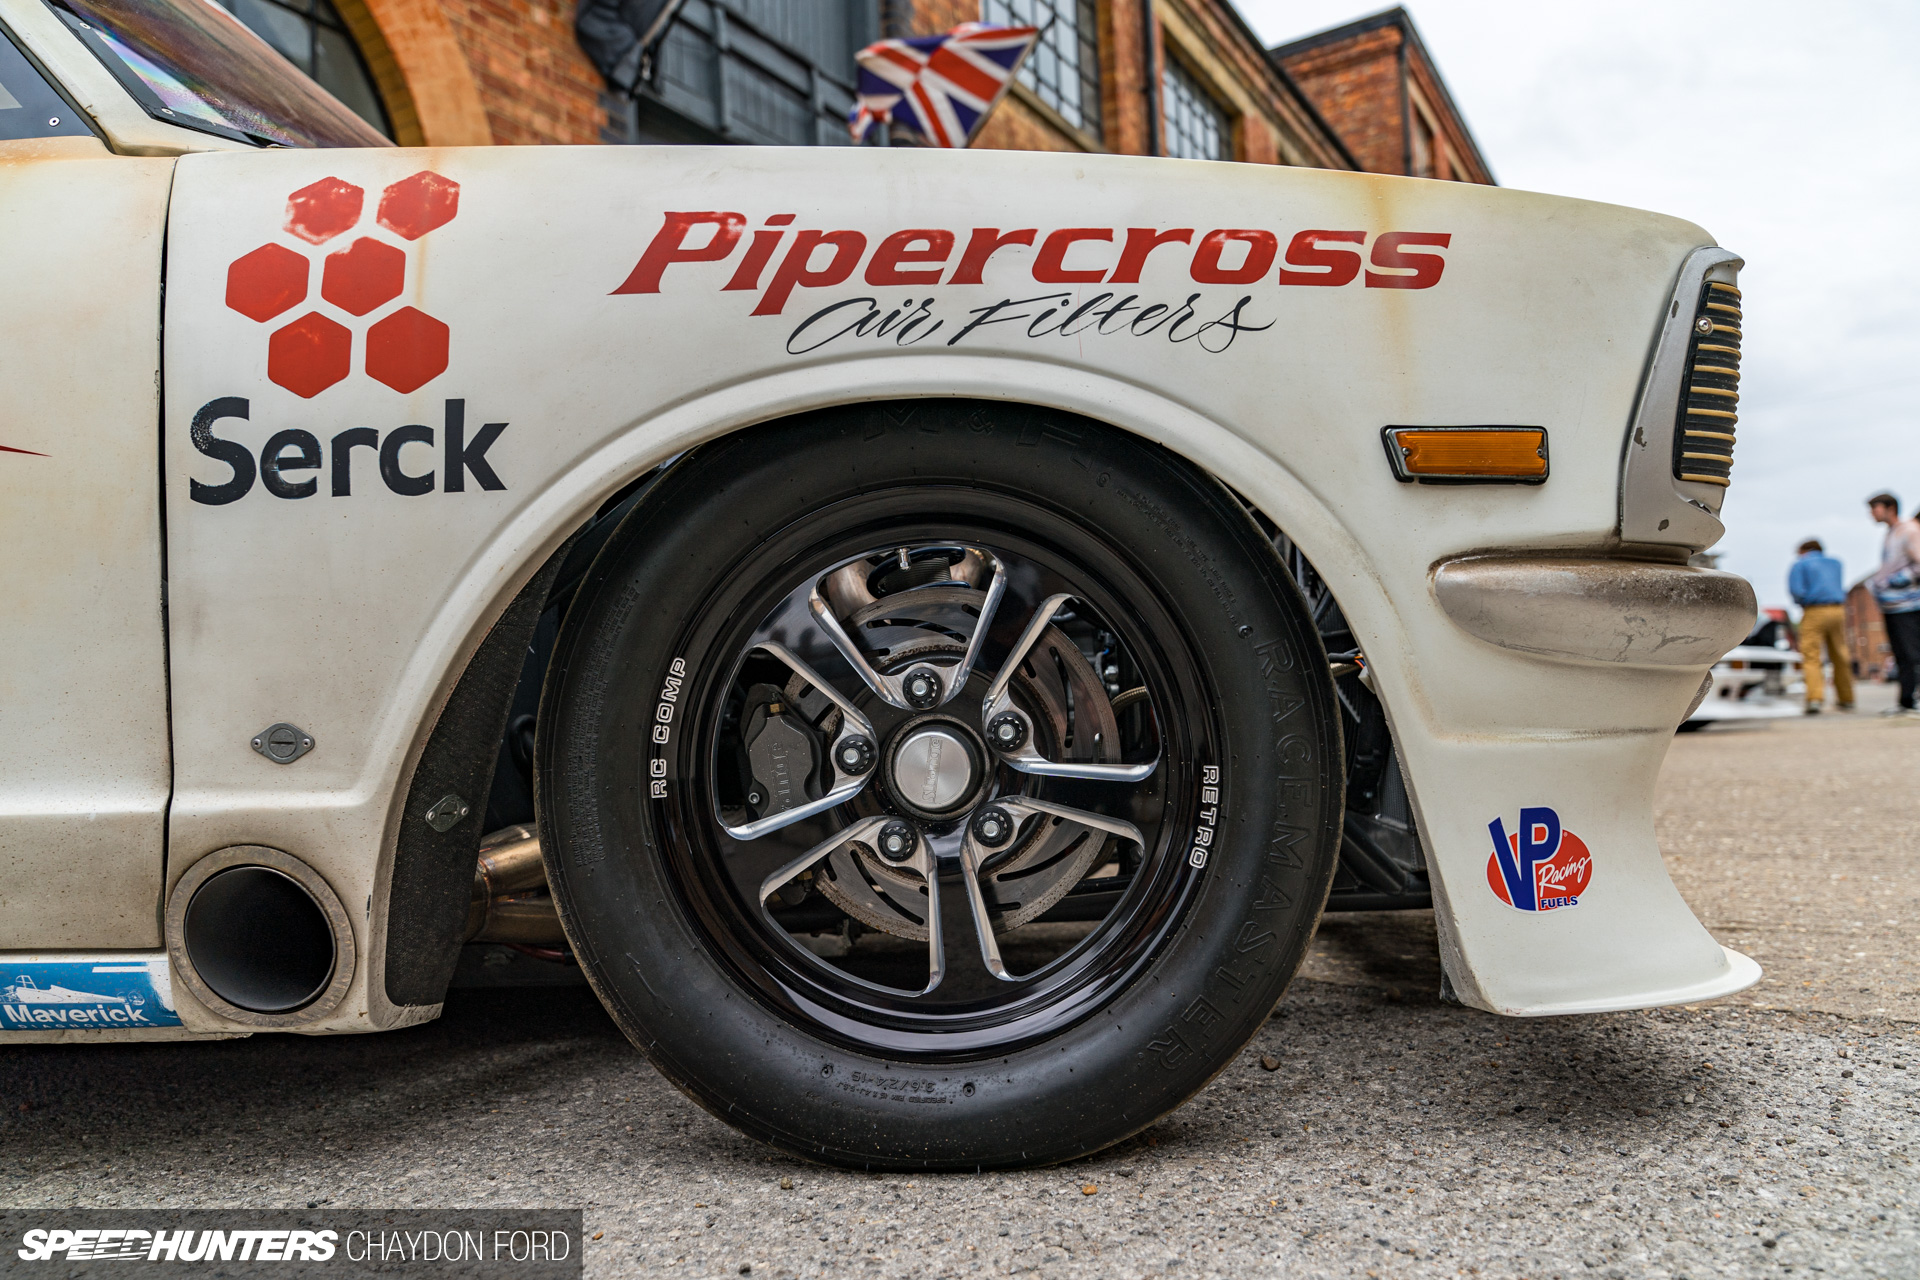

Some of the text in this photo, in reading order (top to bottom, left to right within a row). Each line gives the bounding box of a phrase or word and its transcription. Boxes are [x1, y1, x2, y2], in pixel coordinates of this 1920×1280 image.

[607, 211, 1452, 316] Pipercross
[948, 292, 1277, 353] Filters
[190, 396, 509, 505] Serck
[650, 657, 686, 798] RC COMP
[1146, 637, 1313, 1071] RACEMASTER
[1189, 765, 1219, 869] RETRO
[1488, 807, 1560, 911] VP
[1538, 855, 1592, 898] Racing
[1541, 896, 1578, 909] FUELS
[3, 1004, 150, 1024] Maverick
